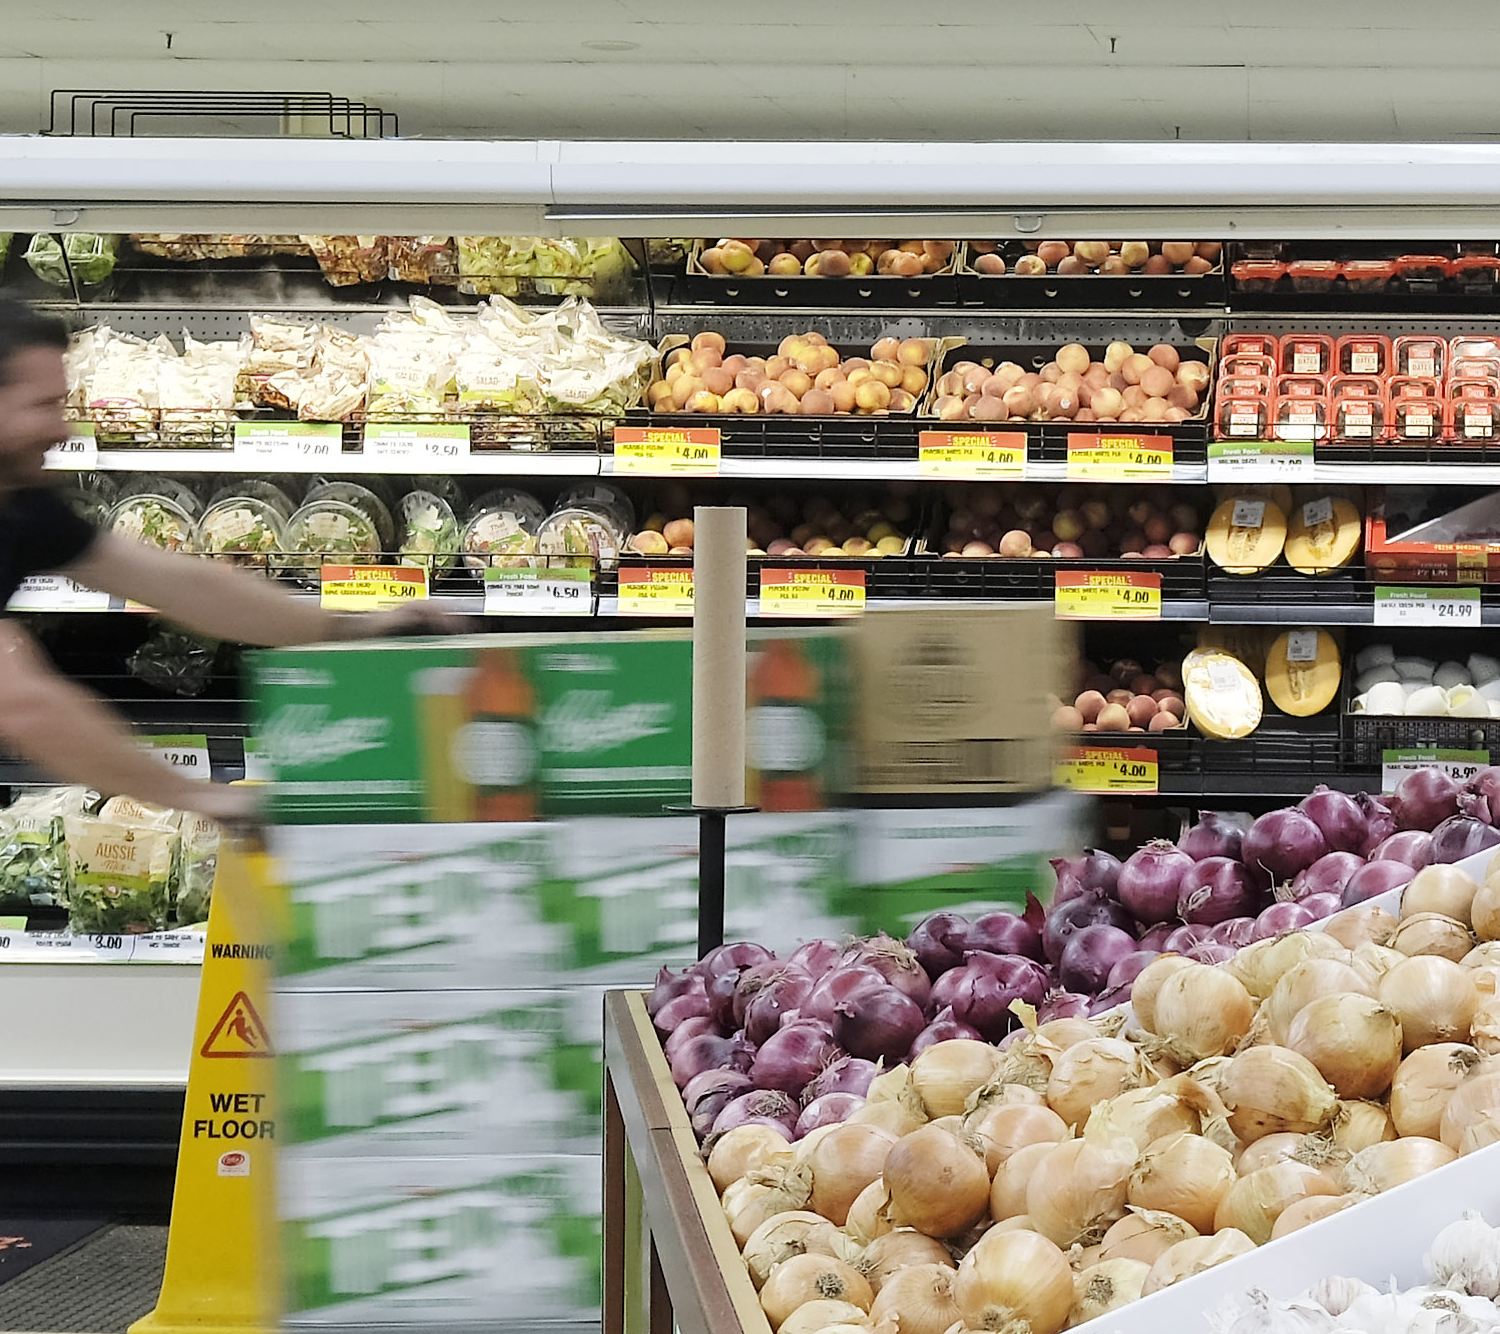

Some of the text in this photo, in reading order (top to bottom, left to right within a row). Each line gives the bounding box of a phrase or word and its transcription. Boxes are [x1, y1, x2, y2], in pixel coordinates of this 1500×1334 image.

[647, 431, 687, 443] SPECIAL
[952, 436, 991, 447] SPECIAL
[1101, 438, 1140, 449] SPECIAL
[355, 568, 395, 581] SPECIAL
[651, 571, 691, 584] SPECIAL
[794, 572, 833, 584] SPECIAL
[1089, 574, 1128, 586] SPECIAL
[95, 843, 137, 862] AUSSIE
[211, 943, 275, 959] WARNING
[209, 1093, 265, 1113] WET
[193, 1119, 276, 1139] FLOOR
